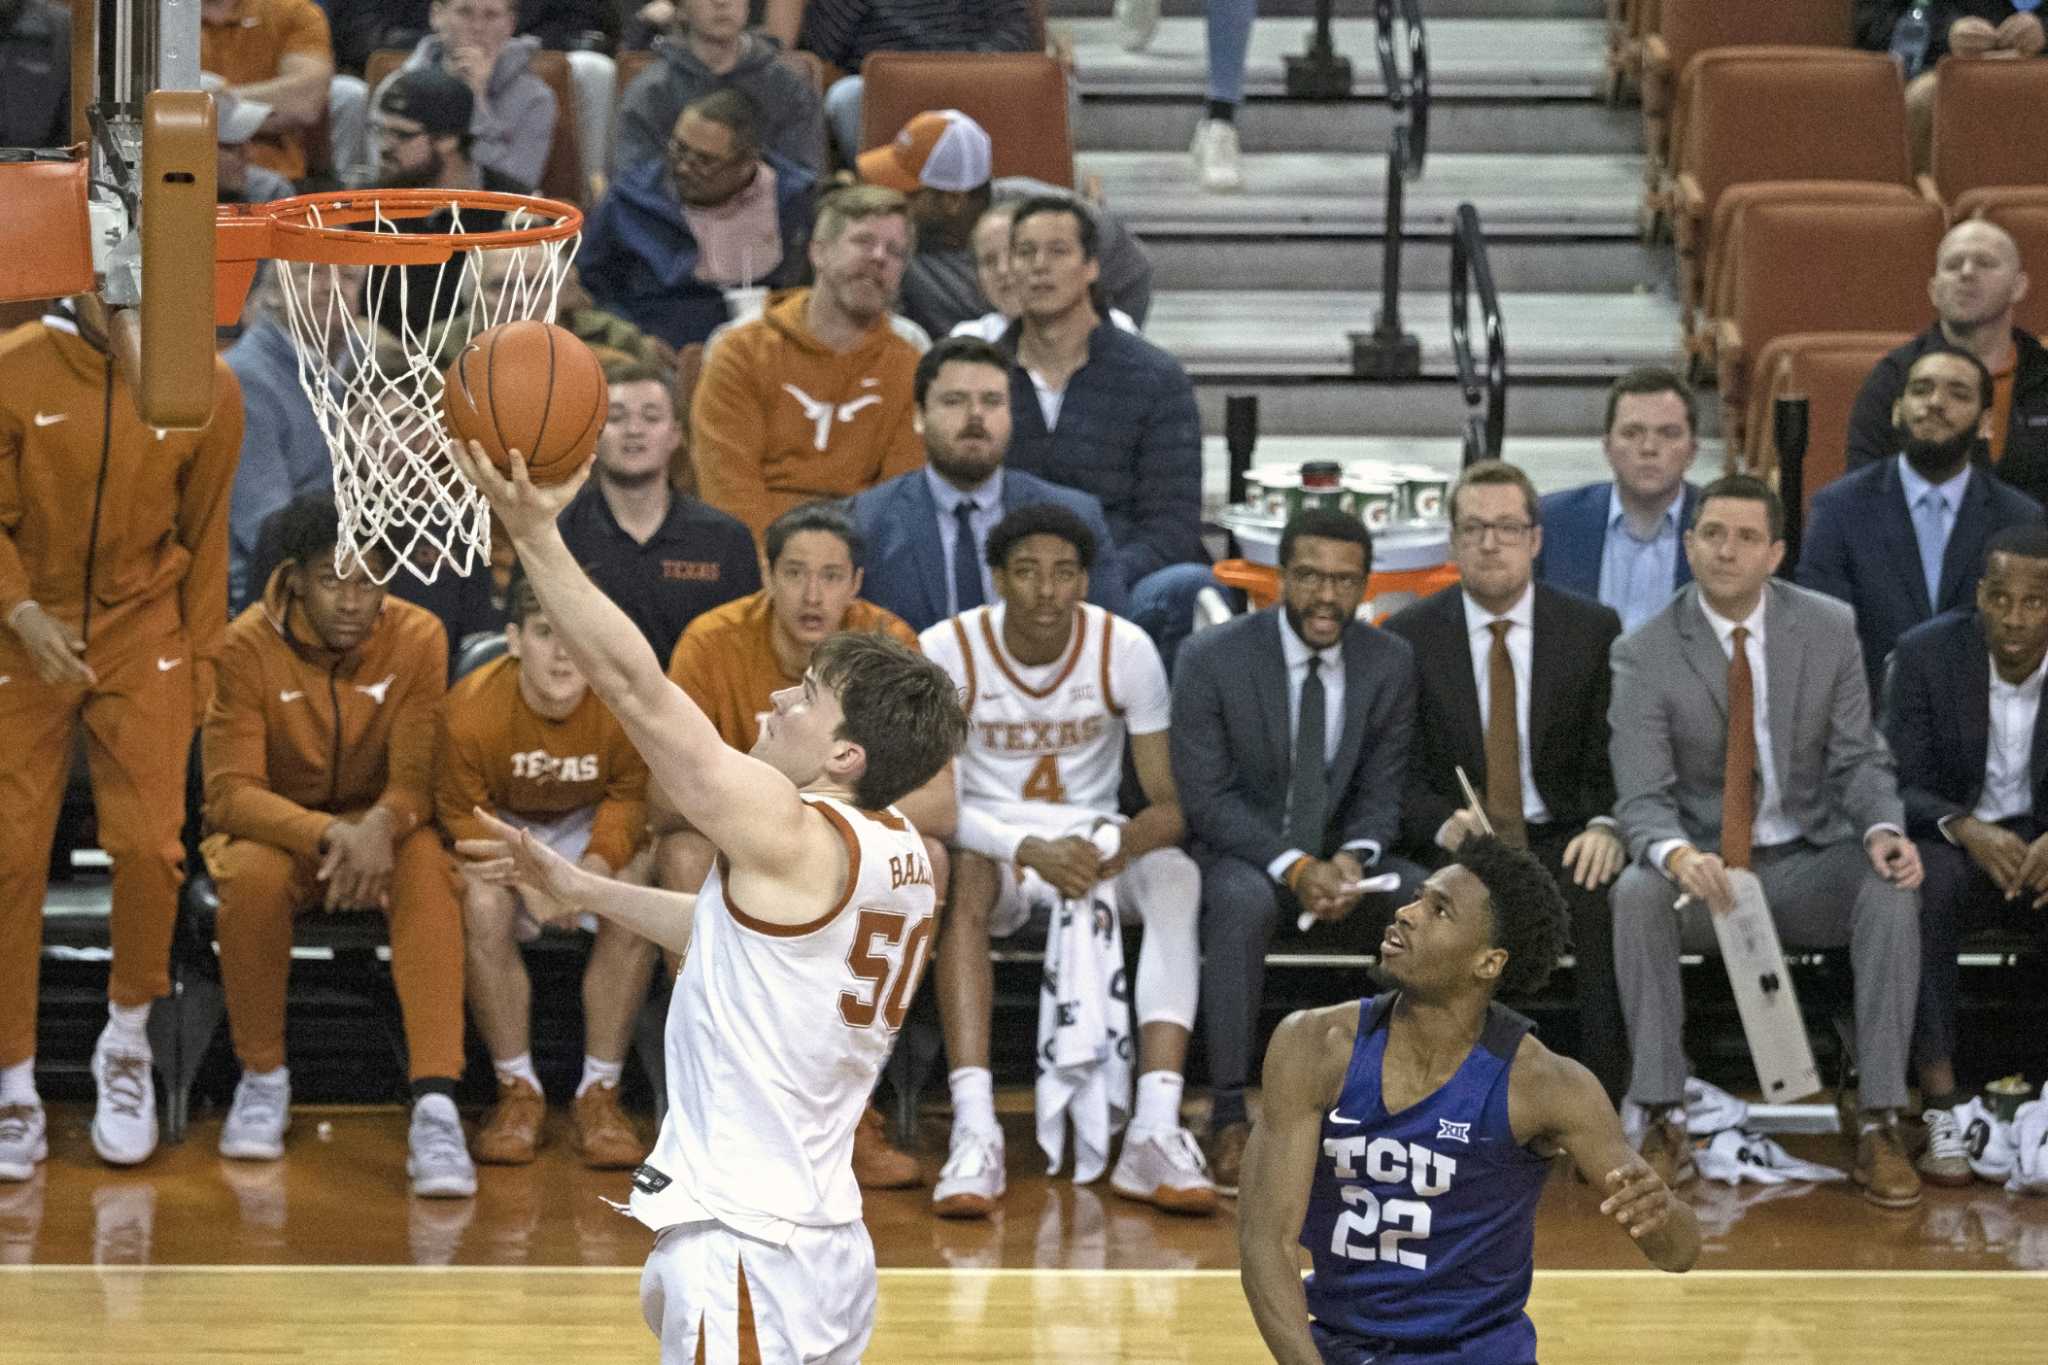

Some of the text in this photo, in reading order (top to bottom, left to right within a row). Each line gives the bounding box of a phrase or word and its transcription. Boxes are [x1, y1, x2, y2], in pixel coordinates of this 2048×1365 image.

[977, 714, 1105, 751] TEXAS
[1022, 753, 1067, 804] 4
[838, 908, 934, 1030] 50
[1323, 1136, 1456, 1197] TCU
[1331, 1185, 1432, 1271] 22
